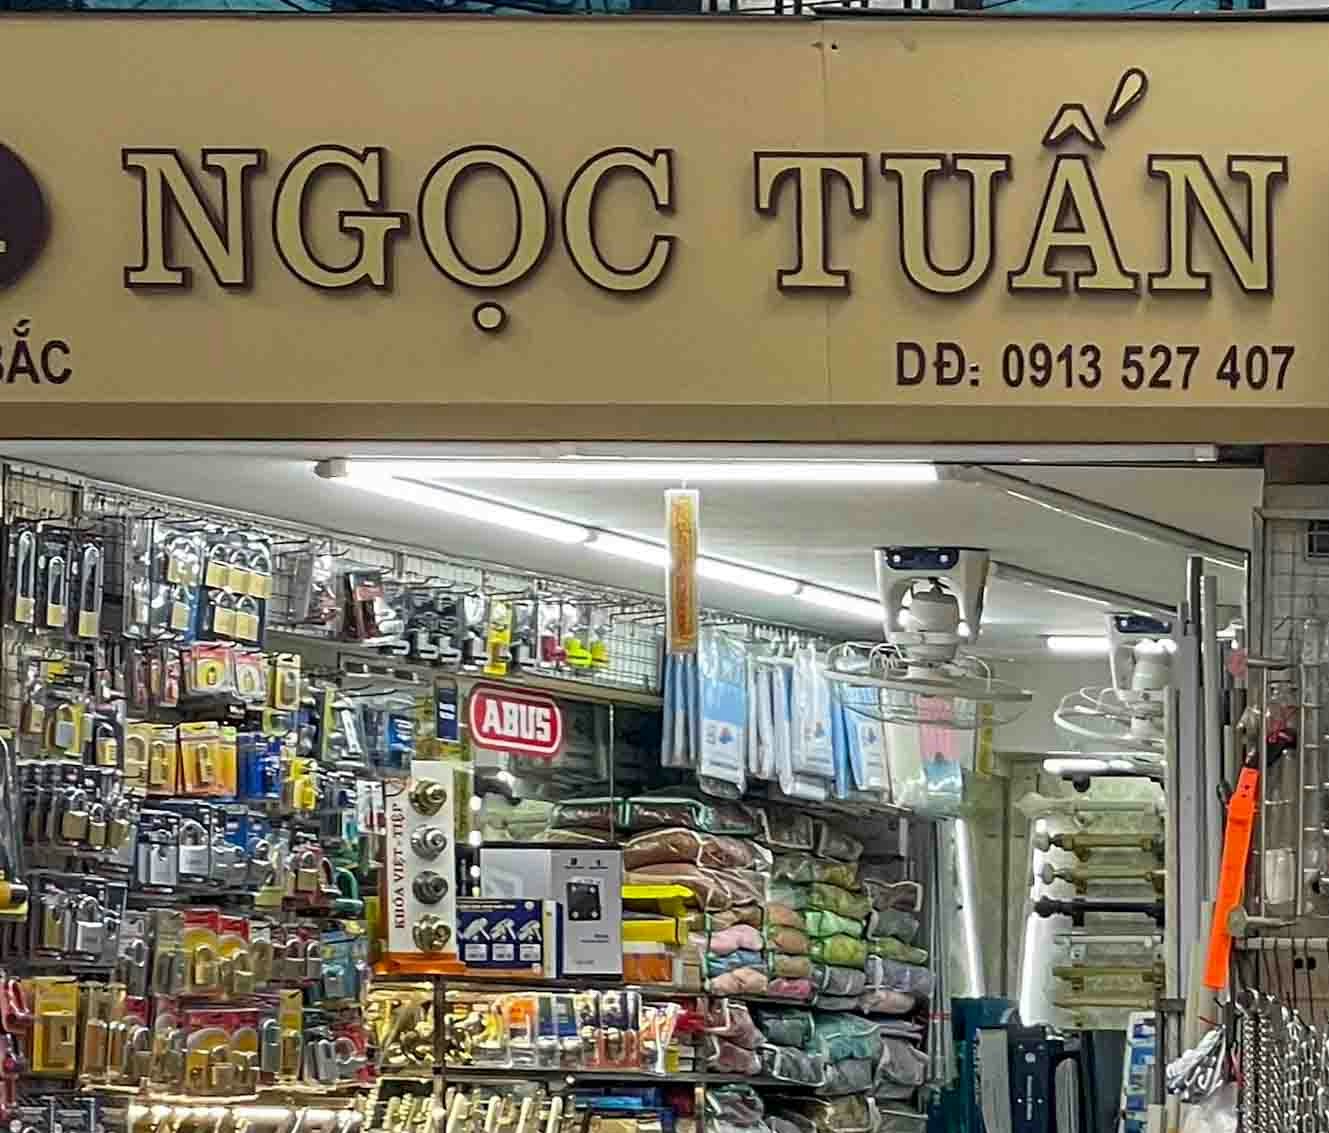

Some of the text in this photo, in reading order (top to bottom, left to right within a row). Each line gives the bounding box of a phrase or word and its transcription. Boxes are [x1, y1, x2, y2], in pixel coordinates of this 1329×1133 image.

[120, 66, 1289, 336] NGỌC TUẤN
[0, 319, 73, 385] ẮC
[895, 341, 1297, 391] DĐ: 0913 527 407
[482, 698, 552, 743] ABUS
